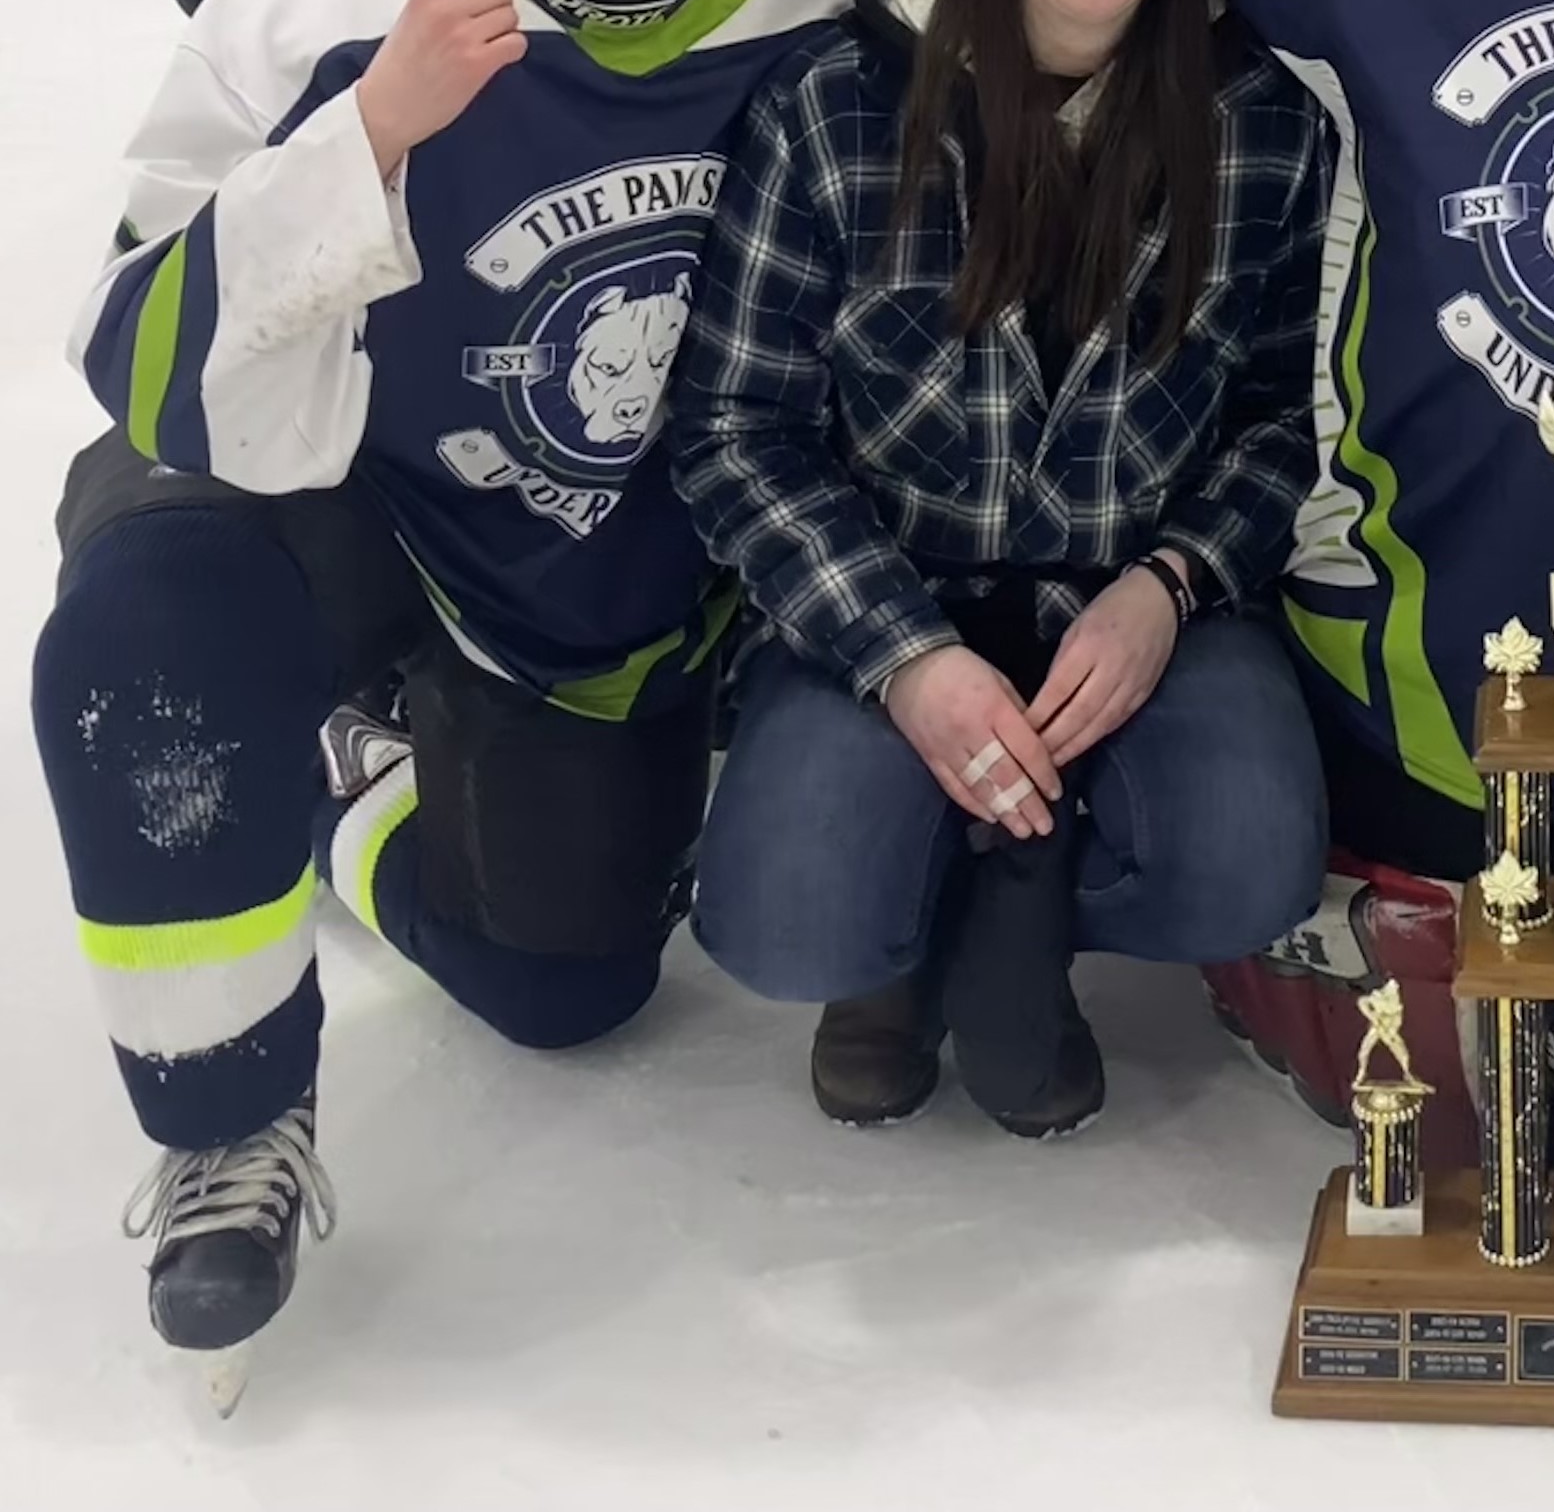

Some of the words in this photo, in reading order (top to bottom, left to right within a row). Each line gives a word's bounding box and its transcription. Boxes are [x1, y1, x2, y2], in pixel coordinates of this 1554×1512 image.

[519, 185, 614, 251] THE
[1459, 194, 1504, 219] EST
[482, 353, 532, 371] EST
